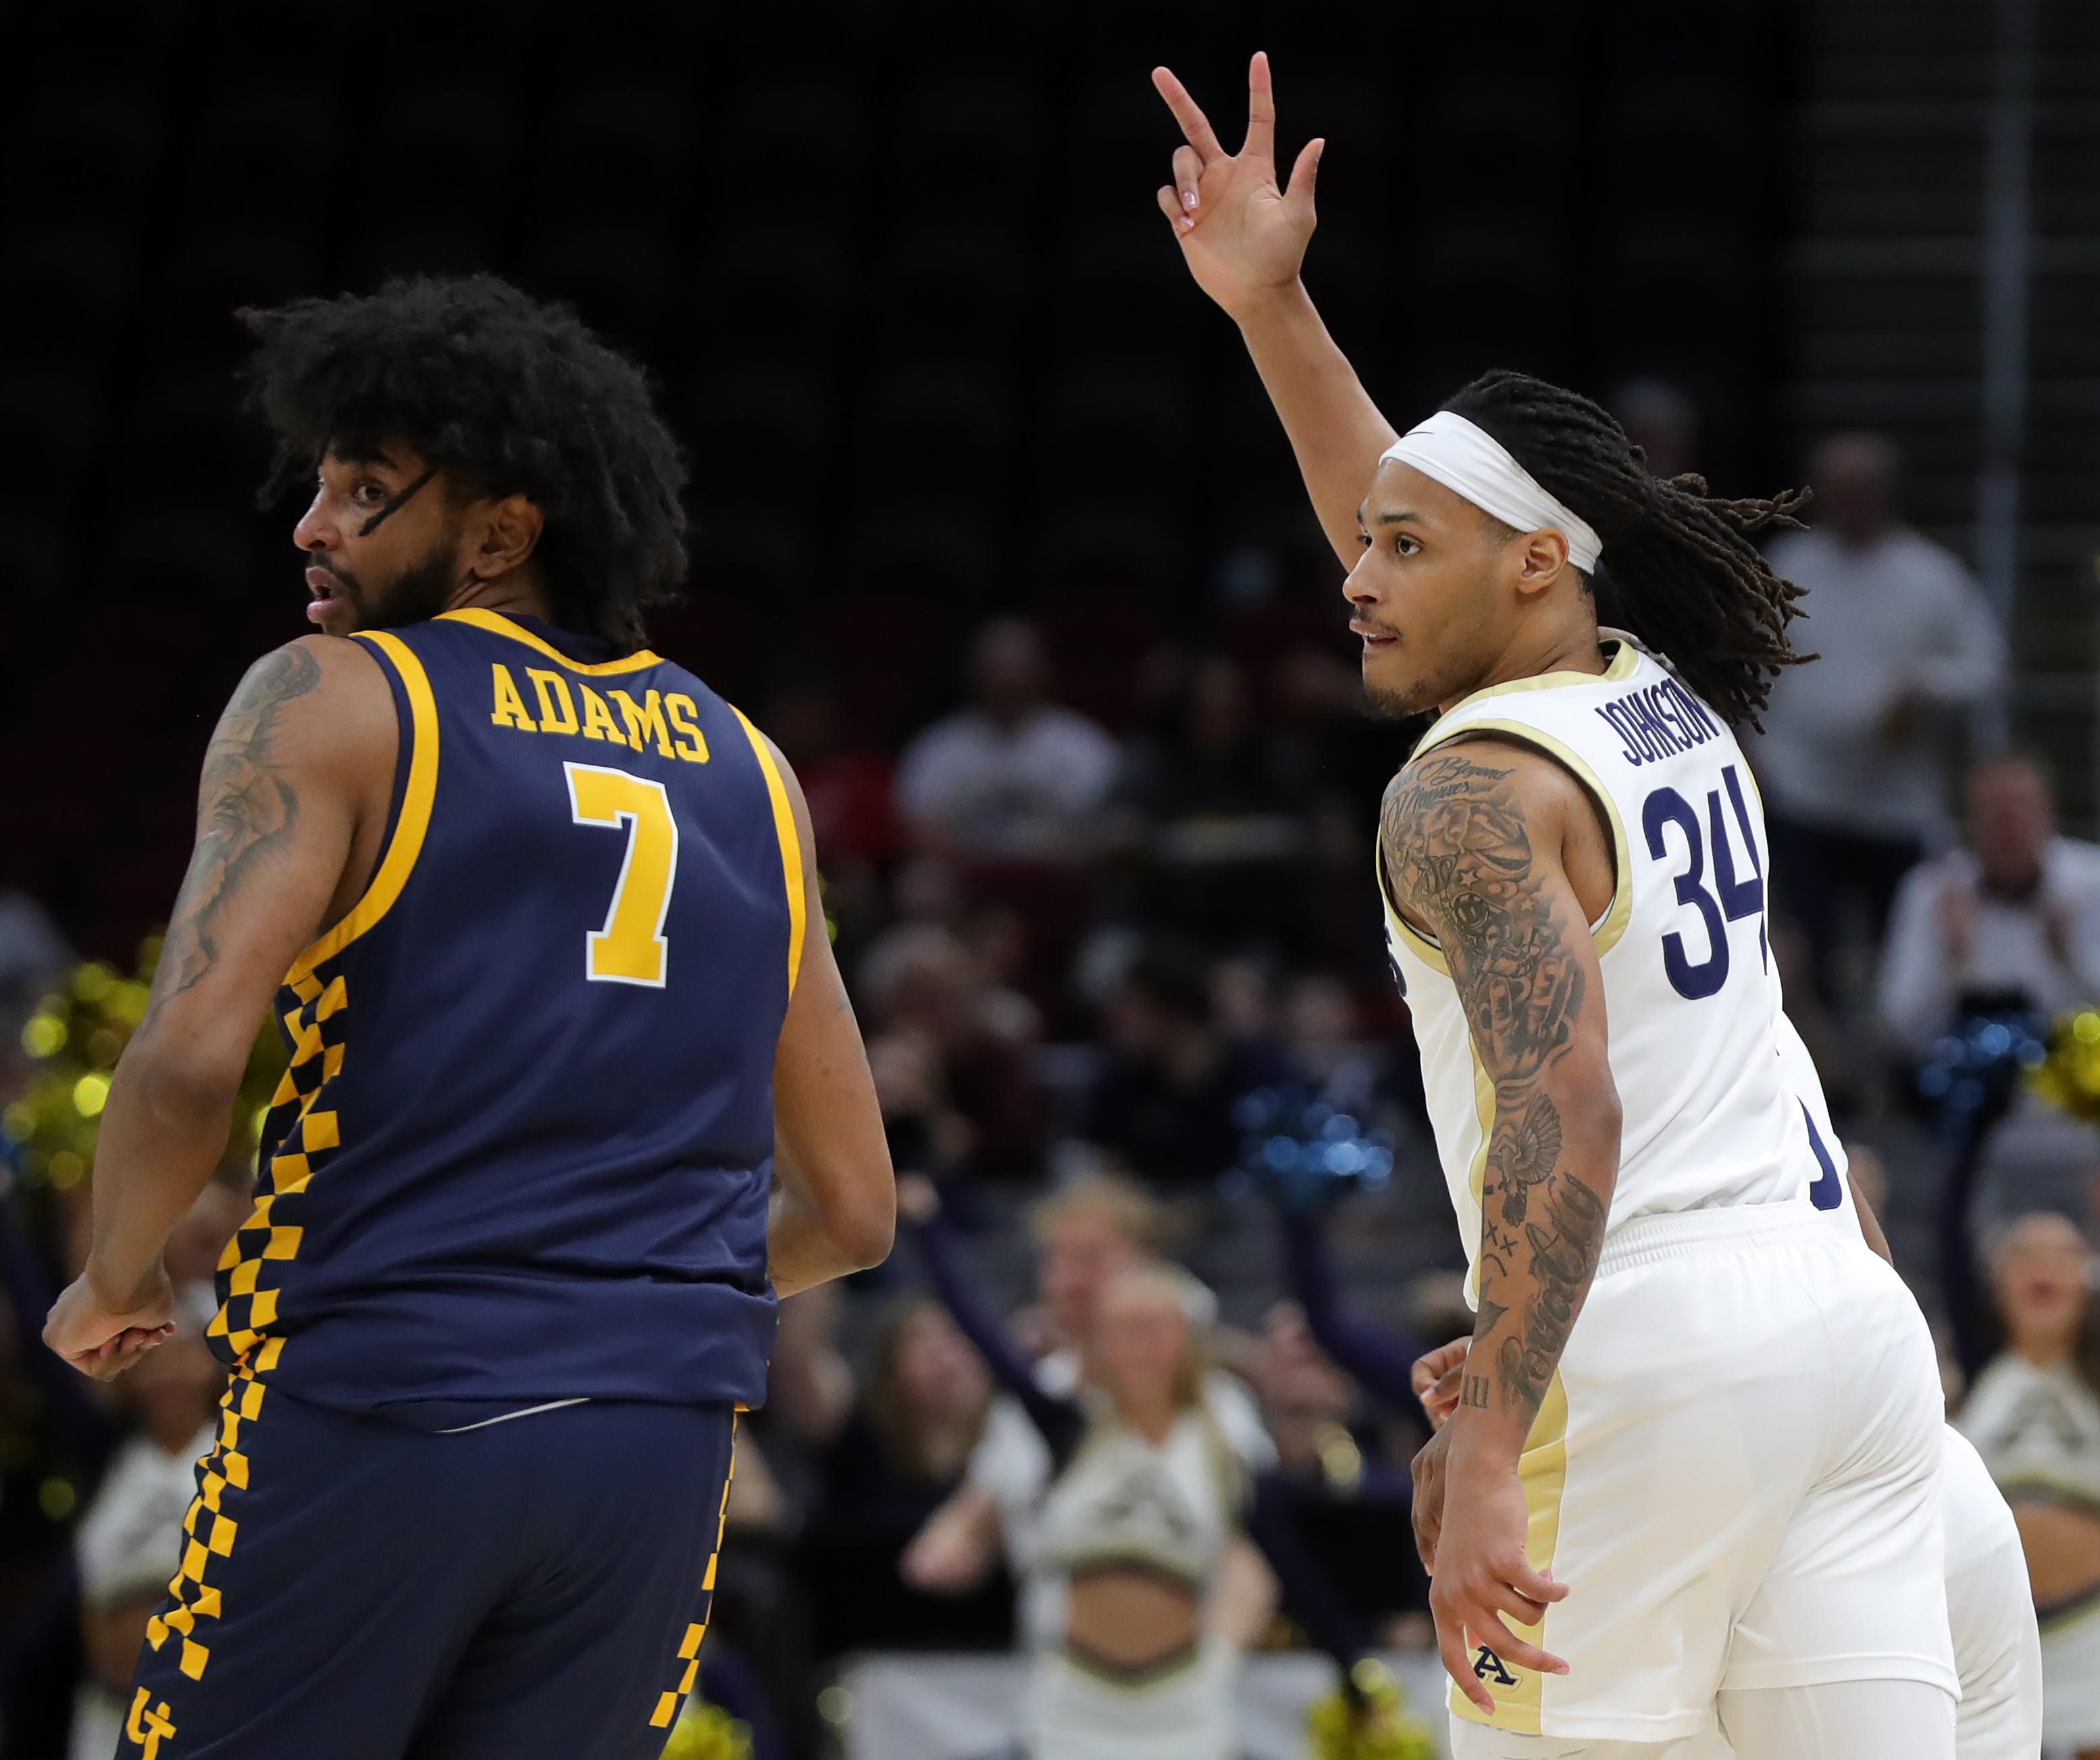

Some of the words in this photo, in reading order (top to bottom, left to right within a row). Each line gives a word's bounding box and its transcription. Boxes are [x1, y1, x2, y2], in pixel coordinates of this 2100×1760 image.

[490, 663, 710, 764] ADAMS
[1595, 677, 1720, 766] JOHNSON
[563, 761, 679, 988] 7
[1642, 764, 1768, 1000] 34
[1473, 1645, 1517, 1685] A
